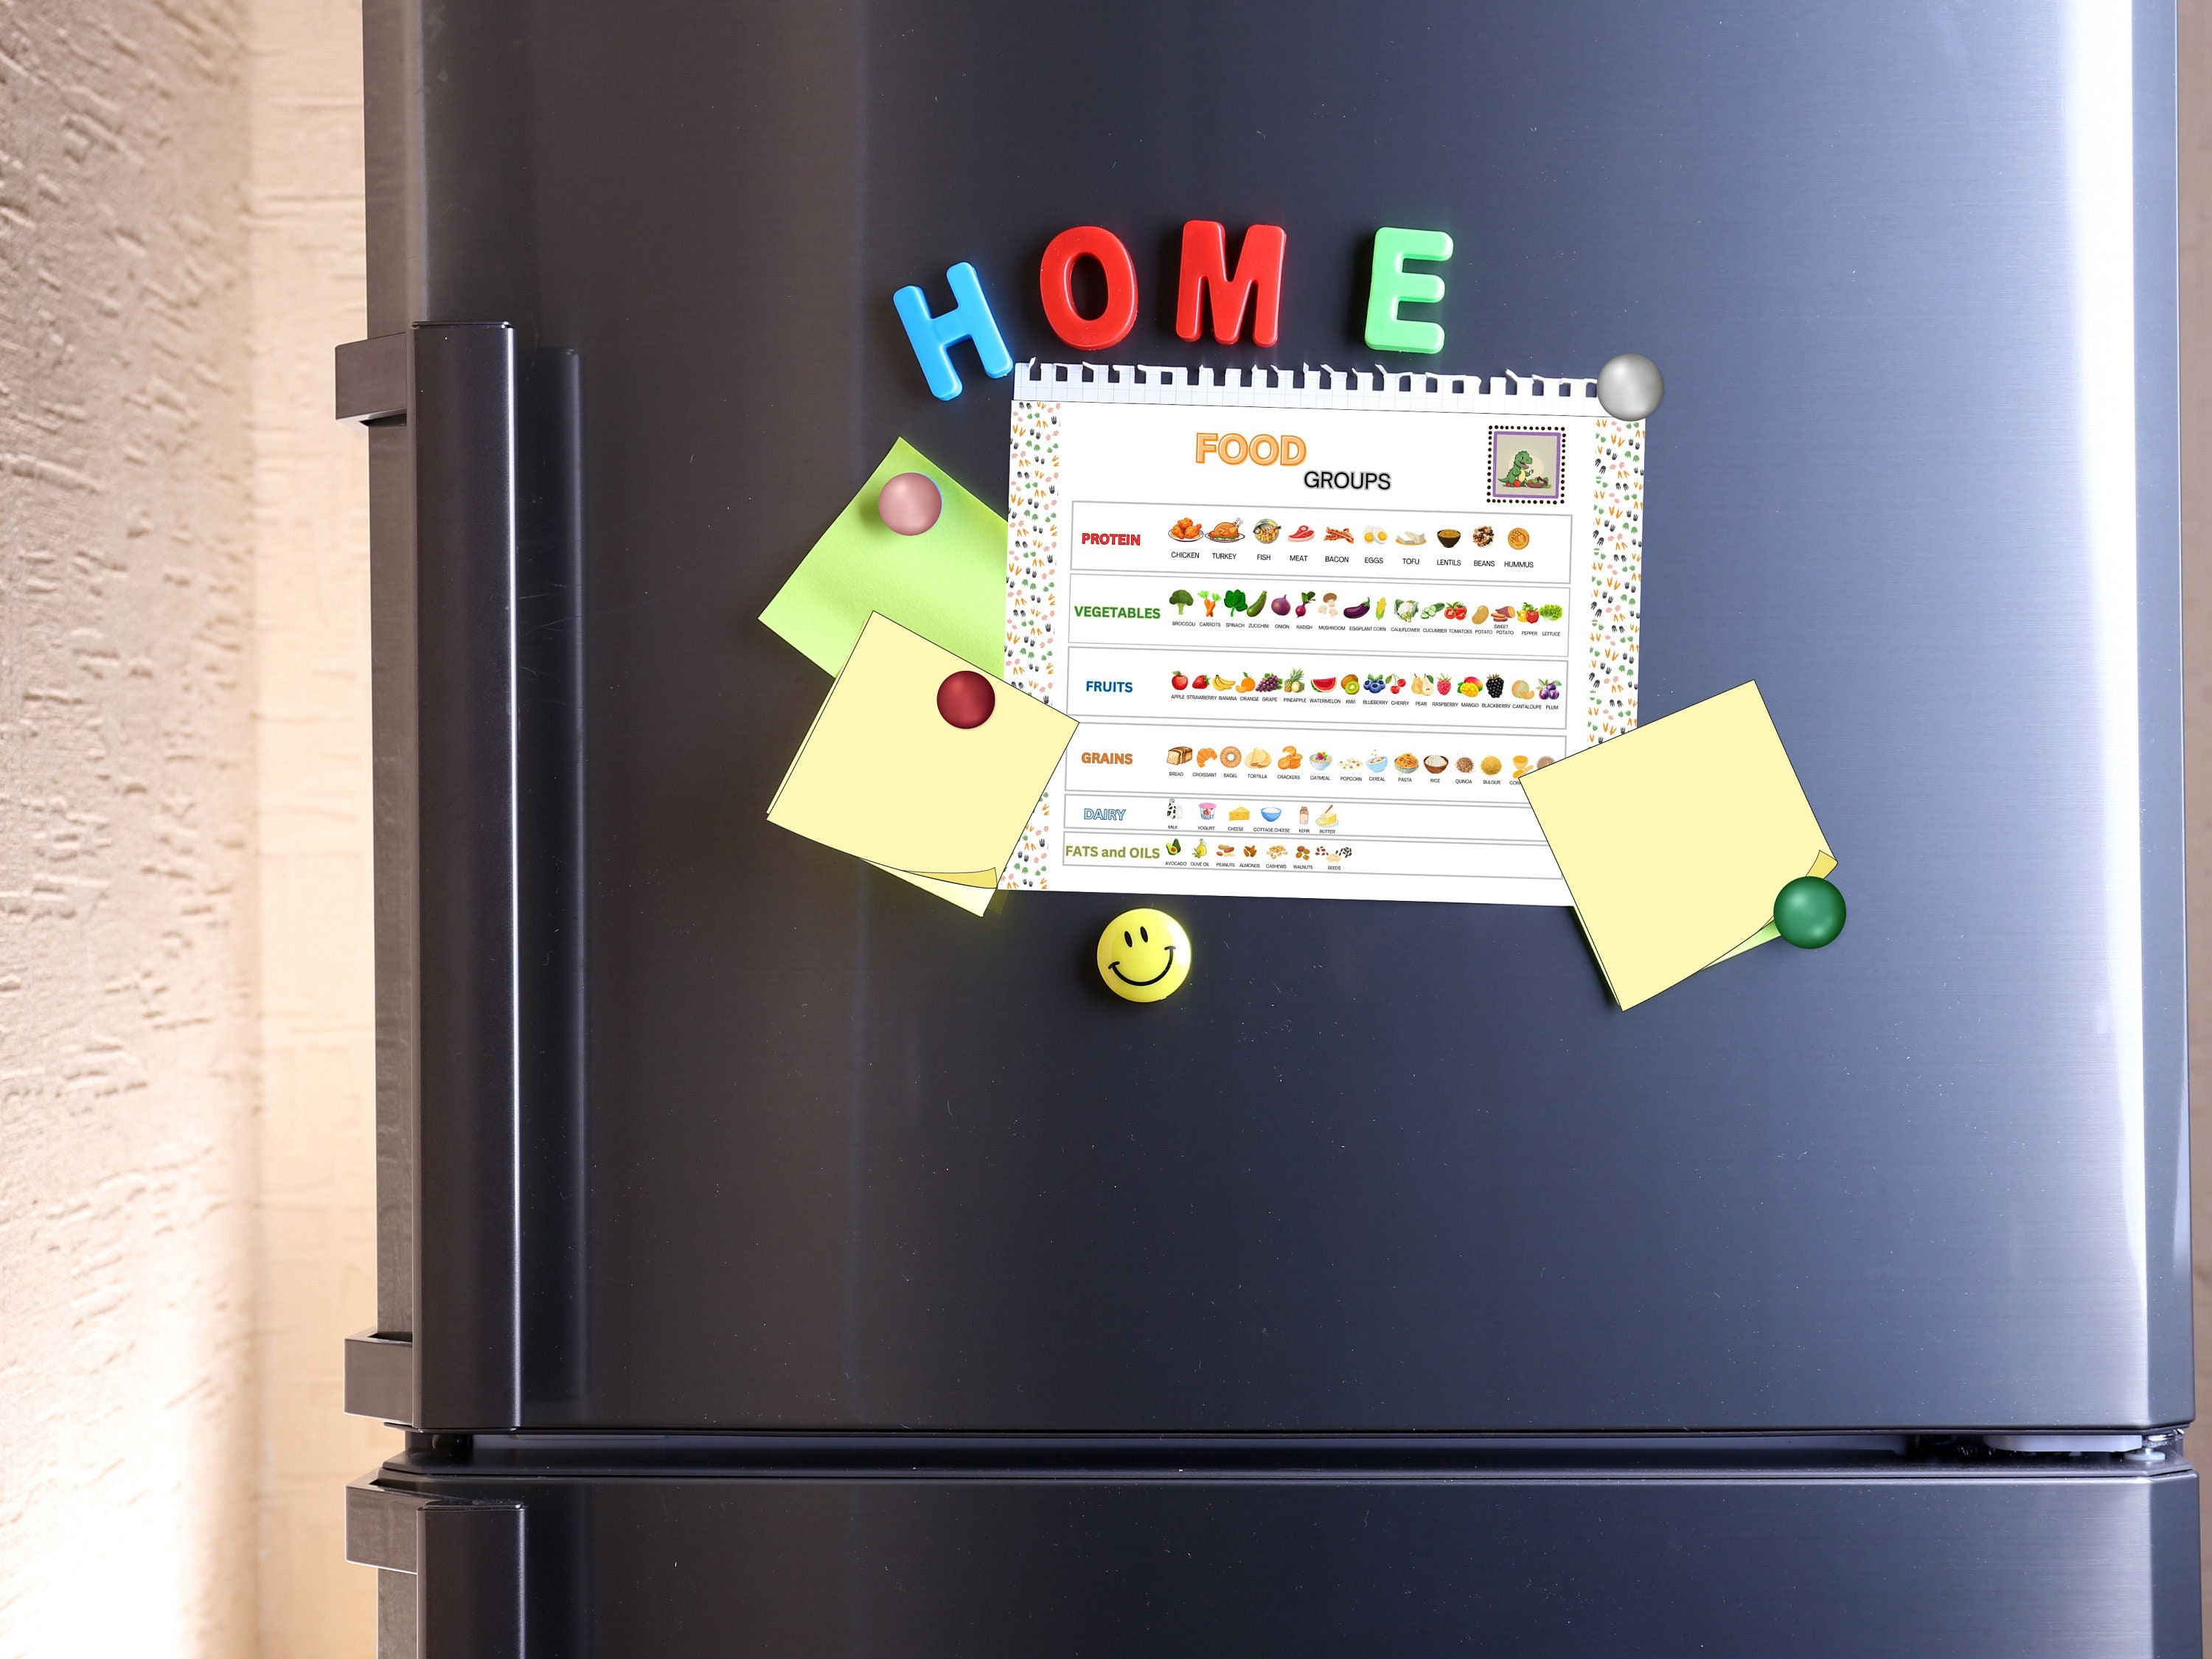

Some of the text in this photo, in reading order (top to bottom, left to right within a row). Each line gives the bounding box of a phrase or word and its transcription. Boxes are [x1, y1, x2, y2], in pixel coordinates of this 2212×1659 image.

[1195, 432, 1307, 467] FOOD
[1304, 470, 1391, 490] GROUPS
[1082, 533, 1141, 546] PROTEIN
[1170, 551, 1200, 559] CHICKEN
[1324, 555, 1349, 563] BACON
[1402, 557, 1420, 566] TOFU
[1503, 560, 1534, 568] HUMMUS
[1074, 606, 1161, 619] VEGETABLES
[1086, 681, 1133, 693] FRUITS
[1082, 752, 1133, 765] GRAINS
[1084, 808, 1126, 821] DAIRY
[1065, 846, 1160, 859] FATS and OILS
